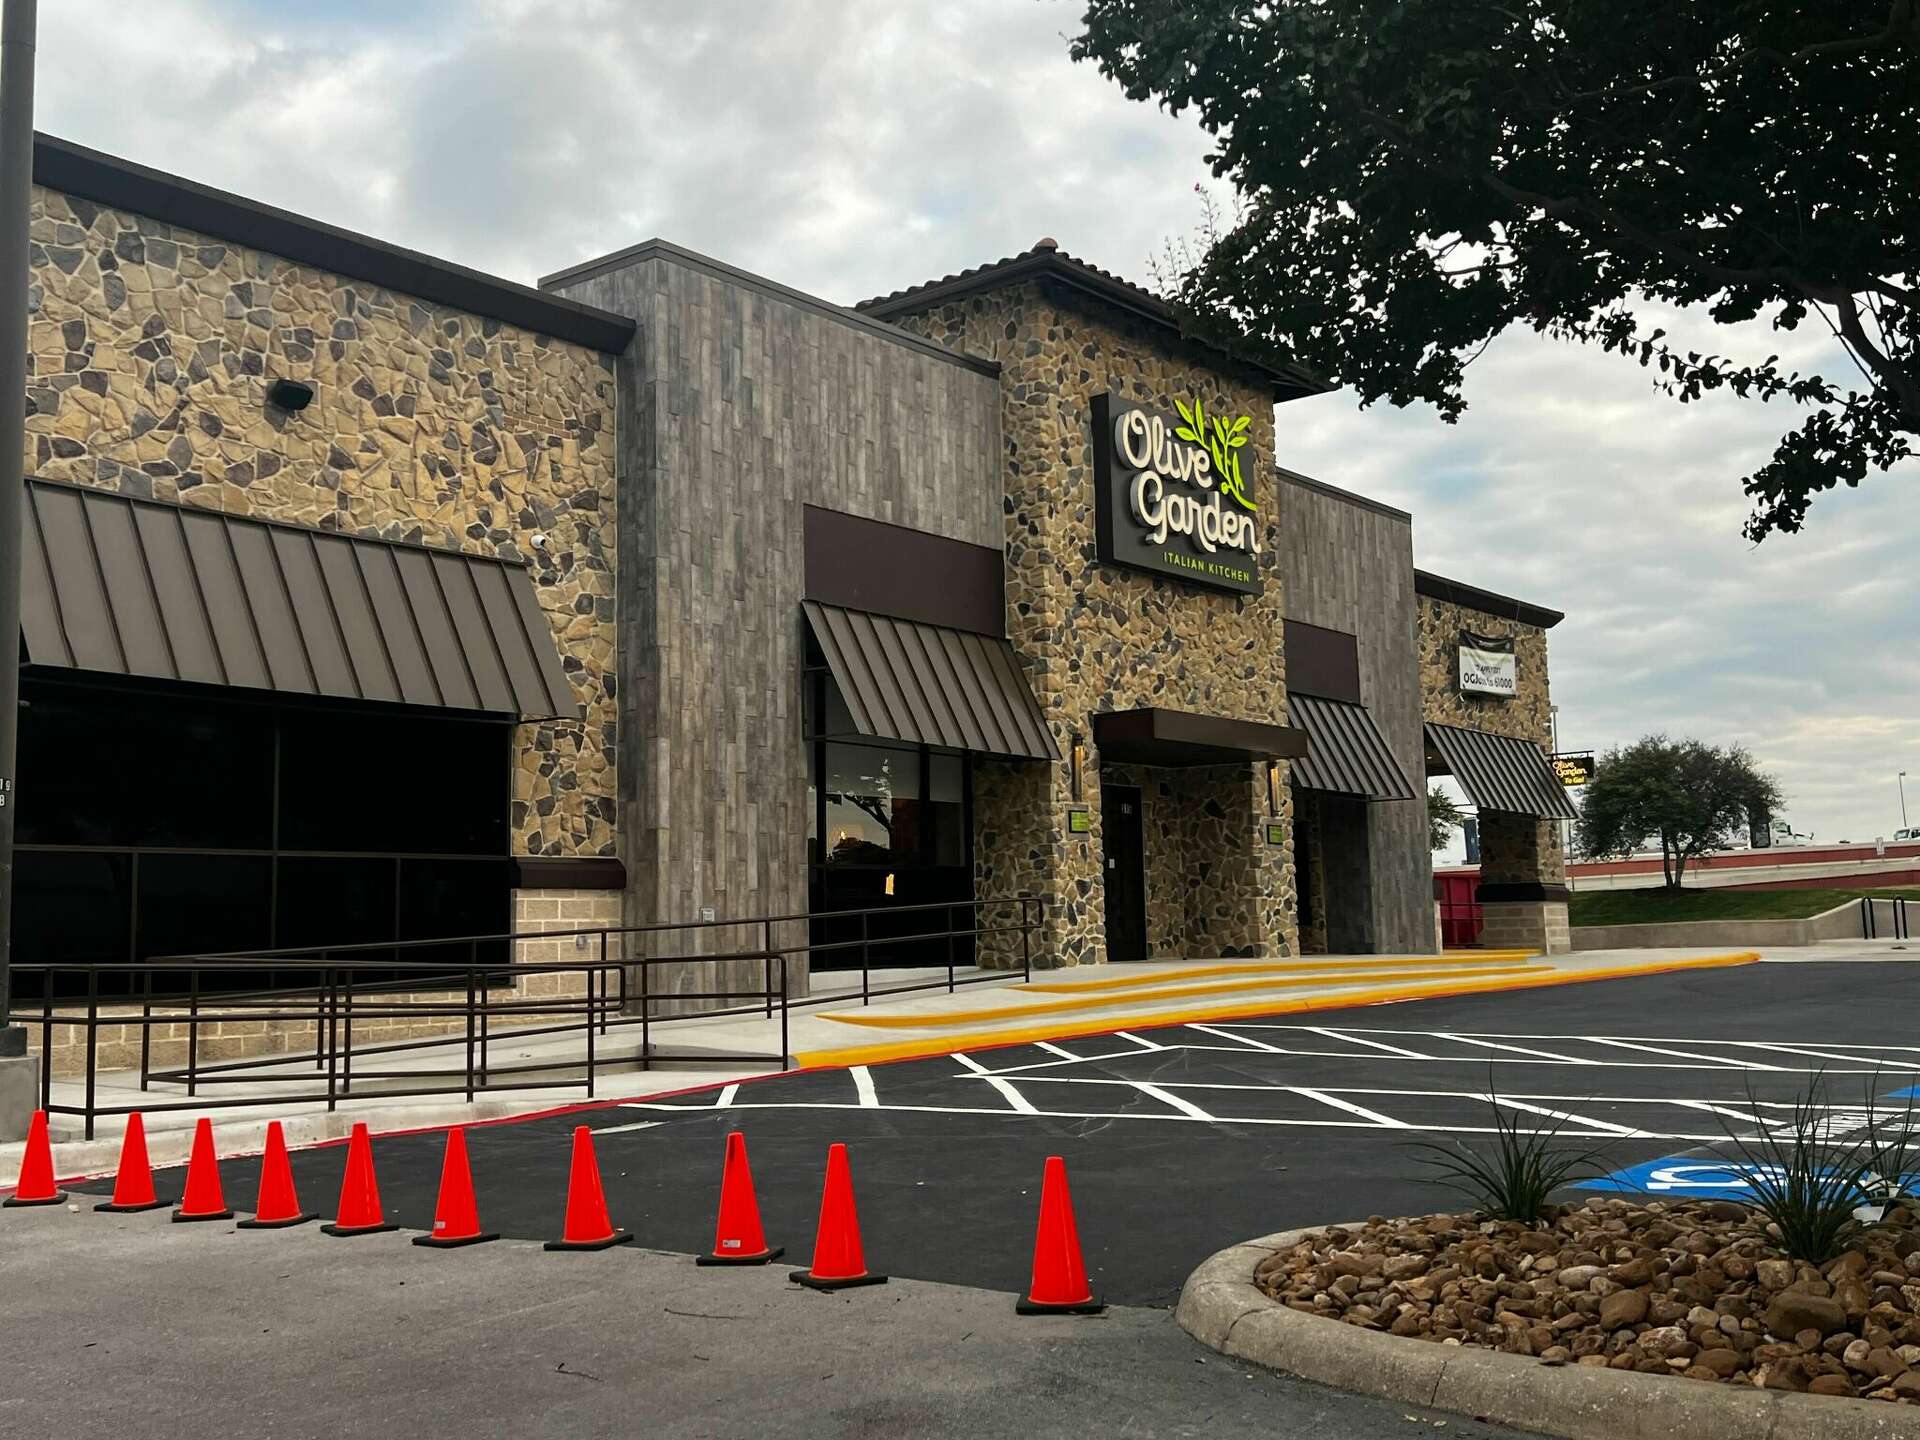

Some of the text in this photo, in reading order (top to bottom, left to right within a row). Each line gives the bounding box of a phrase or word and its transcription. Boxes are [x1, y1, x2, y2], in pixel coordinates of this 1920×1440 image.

[1117, 409, 1213, 489] Olive
[1132, 470, 1262, 554] Garden
[1163, 551, 1250, 582] ITALIAN KITCHEN
[1552, 760, 1575, 769] Olive
[1556, 767, 1587, 778] Garden
